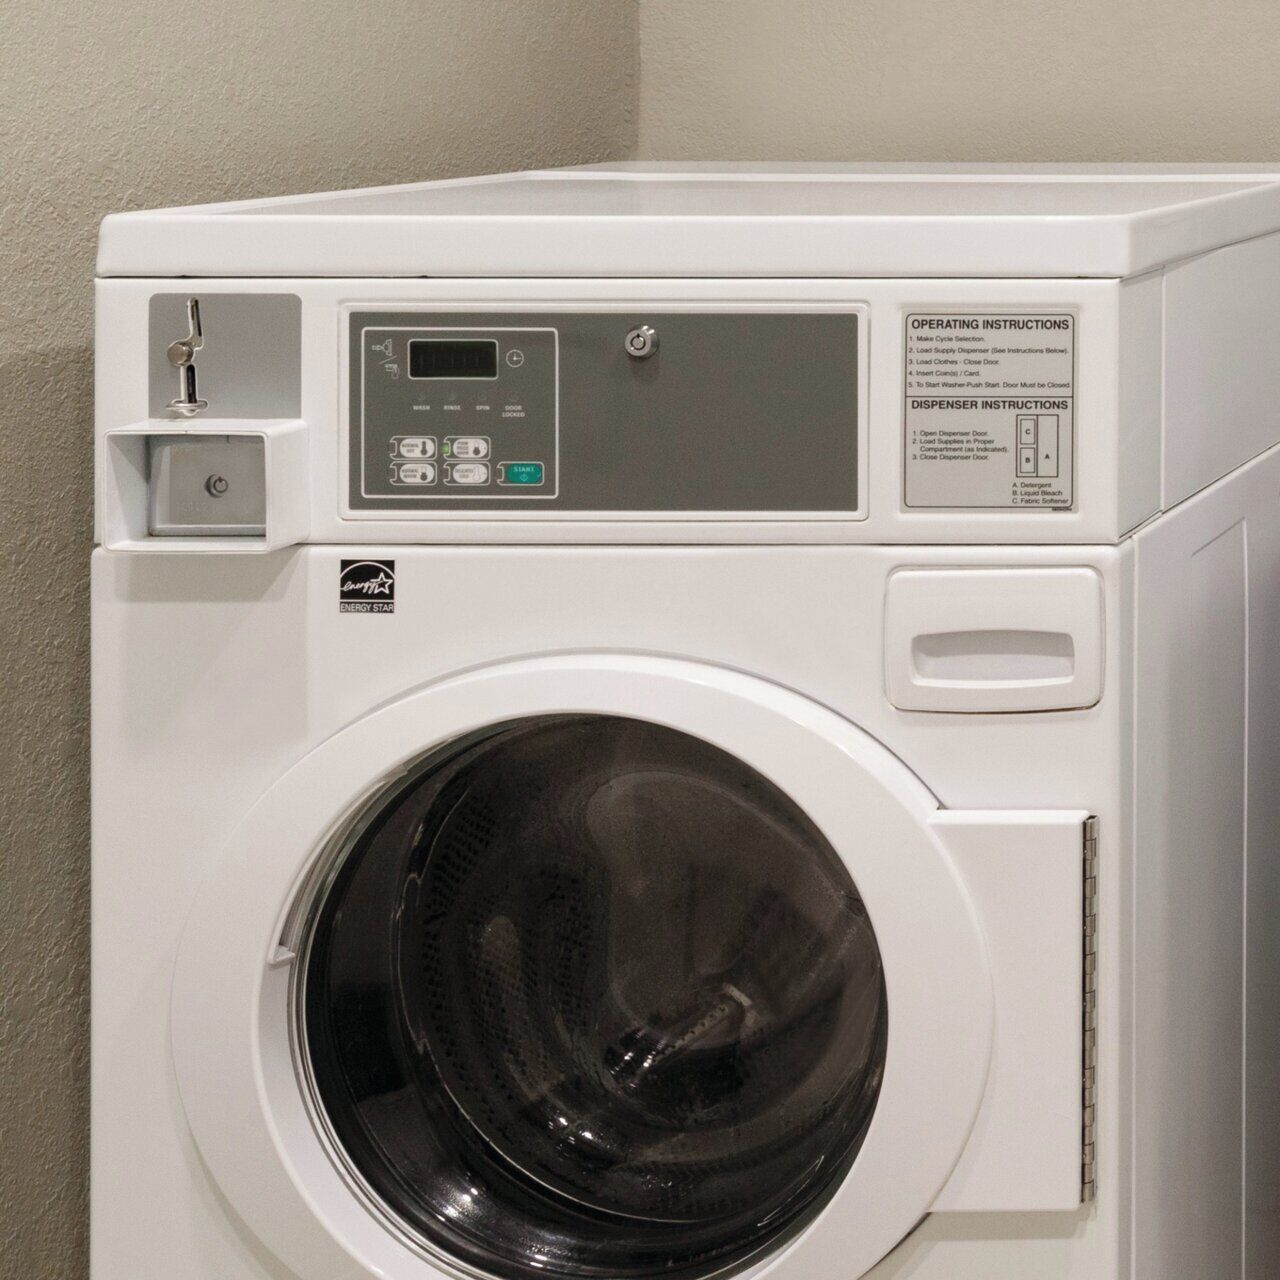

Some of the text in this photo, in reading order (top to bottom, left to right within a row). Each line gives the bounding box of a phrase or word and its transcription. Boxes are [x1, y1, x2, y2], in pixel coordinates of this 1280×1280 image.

[912, 319, 1069, 330] OPERATING INSTRUCTIONS
[912, 400, 1068, 410] DISPENSER INSTRUCTIONS
